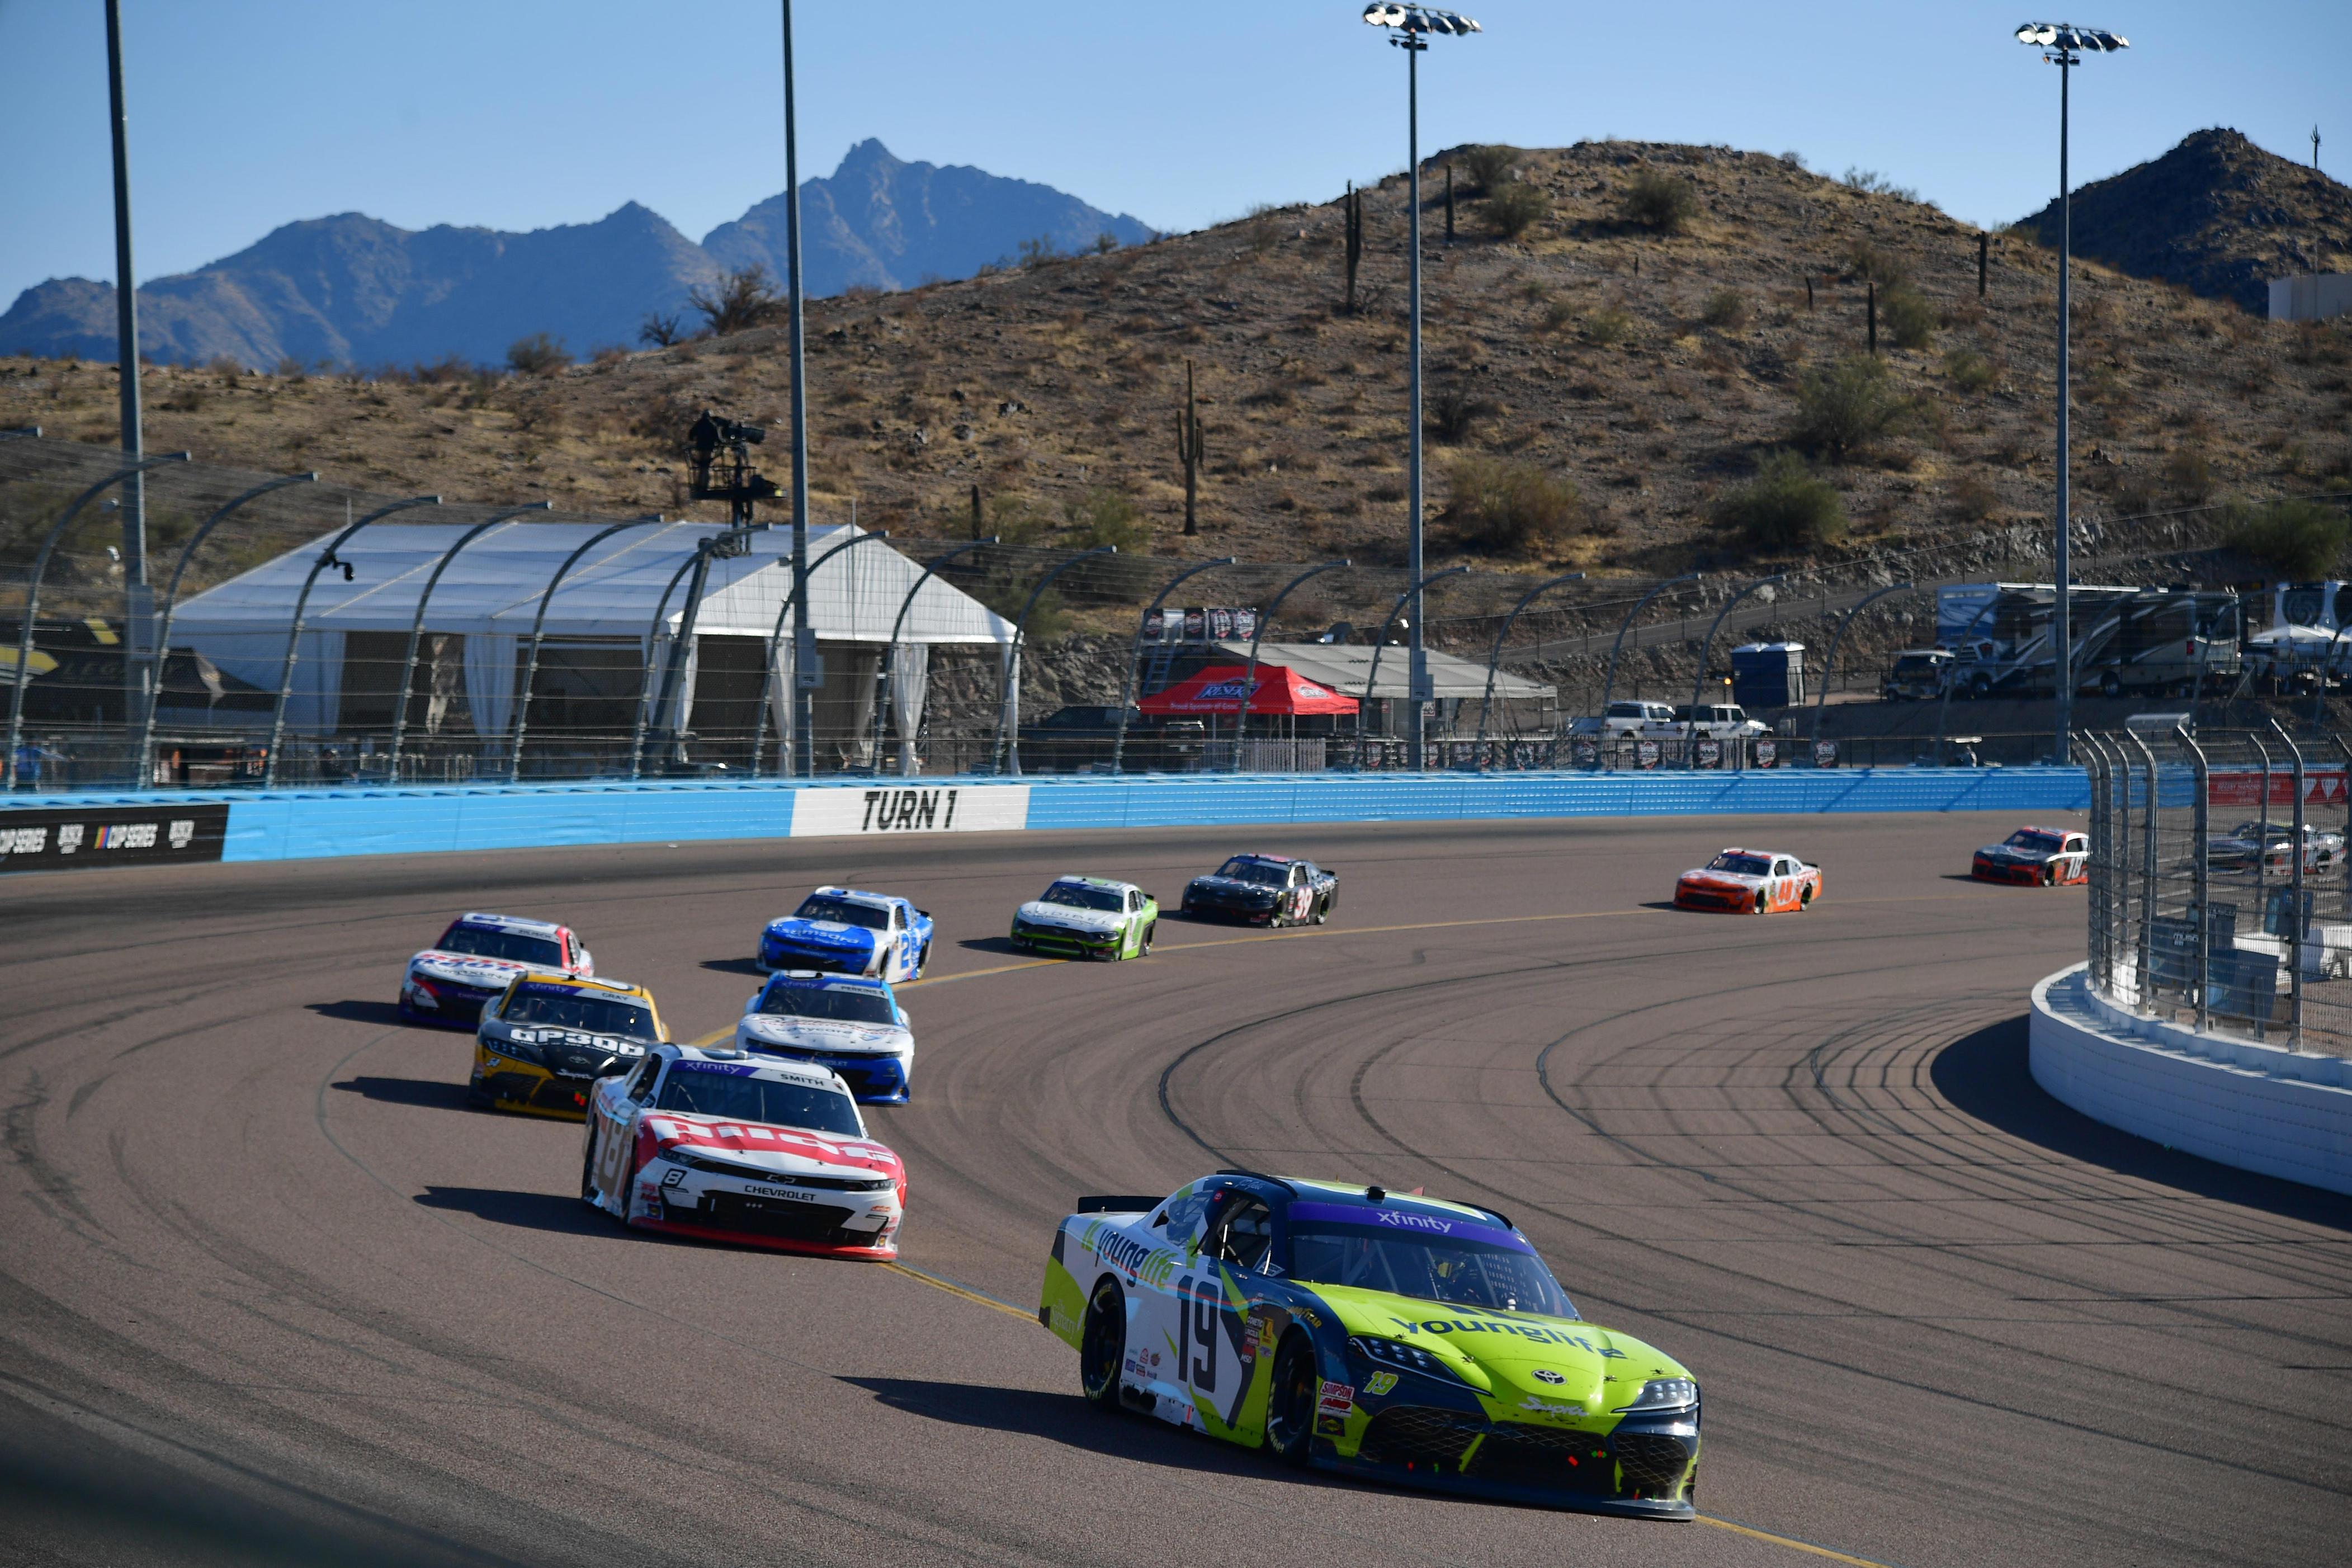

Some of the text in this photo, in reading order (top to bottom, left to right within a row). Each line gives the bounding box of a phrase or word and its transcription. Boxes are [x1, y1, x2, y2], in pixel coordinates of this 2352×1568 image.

[862, 790, 958, 832] TURN 1
[13, 827, 48, 854] SERIES
[106, 823, 158, 849] CUP SERIES
[2066, 856, 2084, 880] 18
[1294, 887, 1314, 920] 39
[781, 928, 860, 944] samsara
[527, 983, 570, 994] xfinity
[602, 992, 628, 1002] GRAY
[840, 985, 879, 994] PERKINS
[685, 1061, 741, 1075] xfinity
[781, 1073, 825, 1087] SMITH
[663, 1169, 683, 1186] 8
[744, 1185, 816, 1201] CHEVROLET
[1378, 1211, 1452, 1234] xfinity
[1177, 1273, 1225, 1394] 19
[1240, 1354, 1253, 1363] MSD
[1322, 1382, 1353, 1399] SIMPSON
[1363, 1371, 1399, 1396] 19
